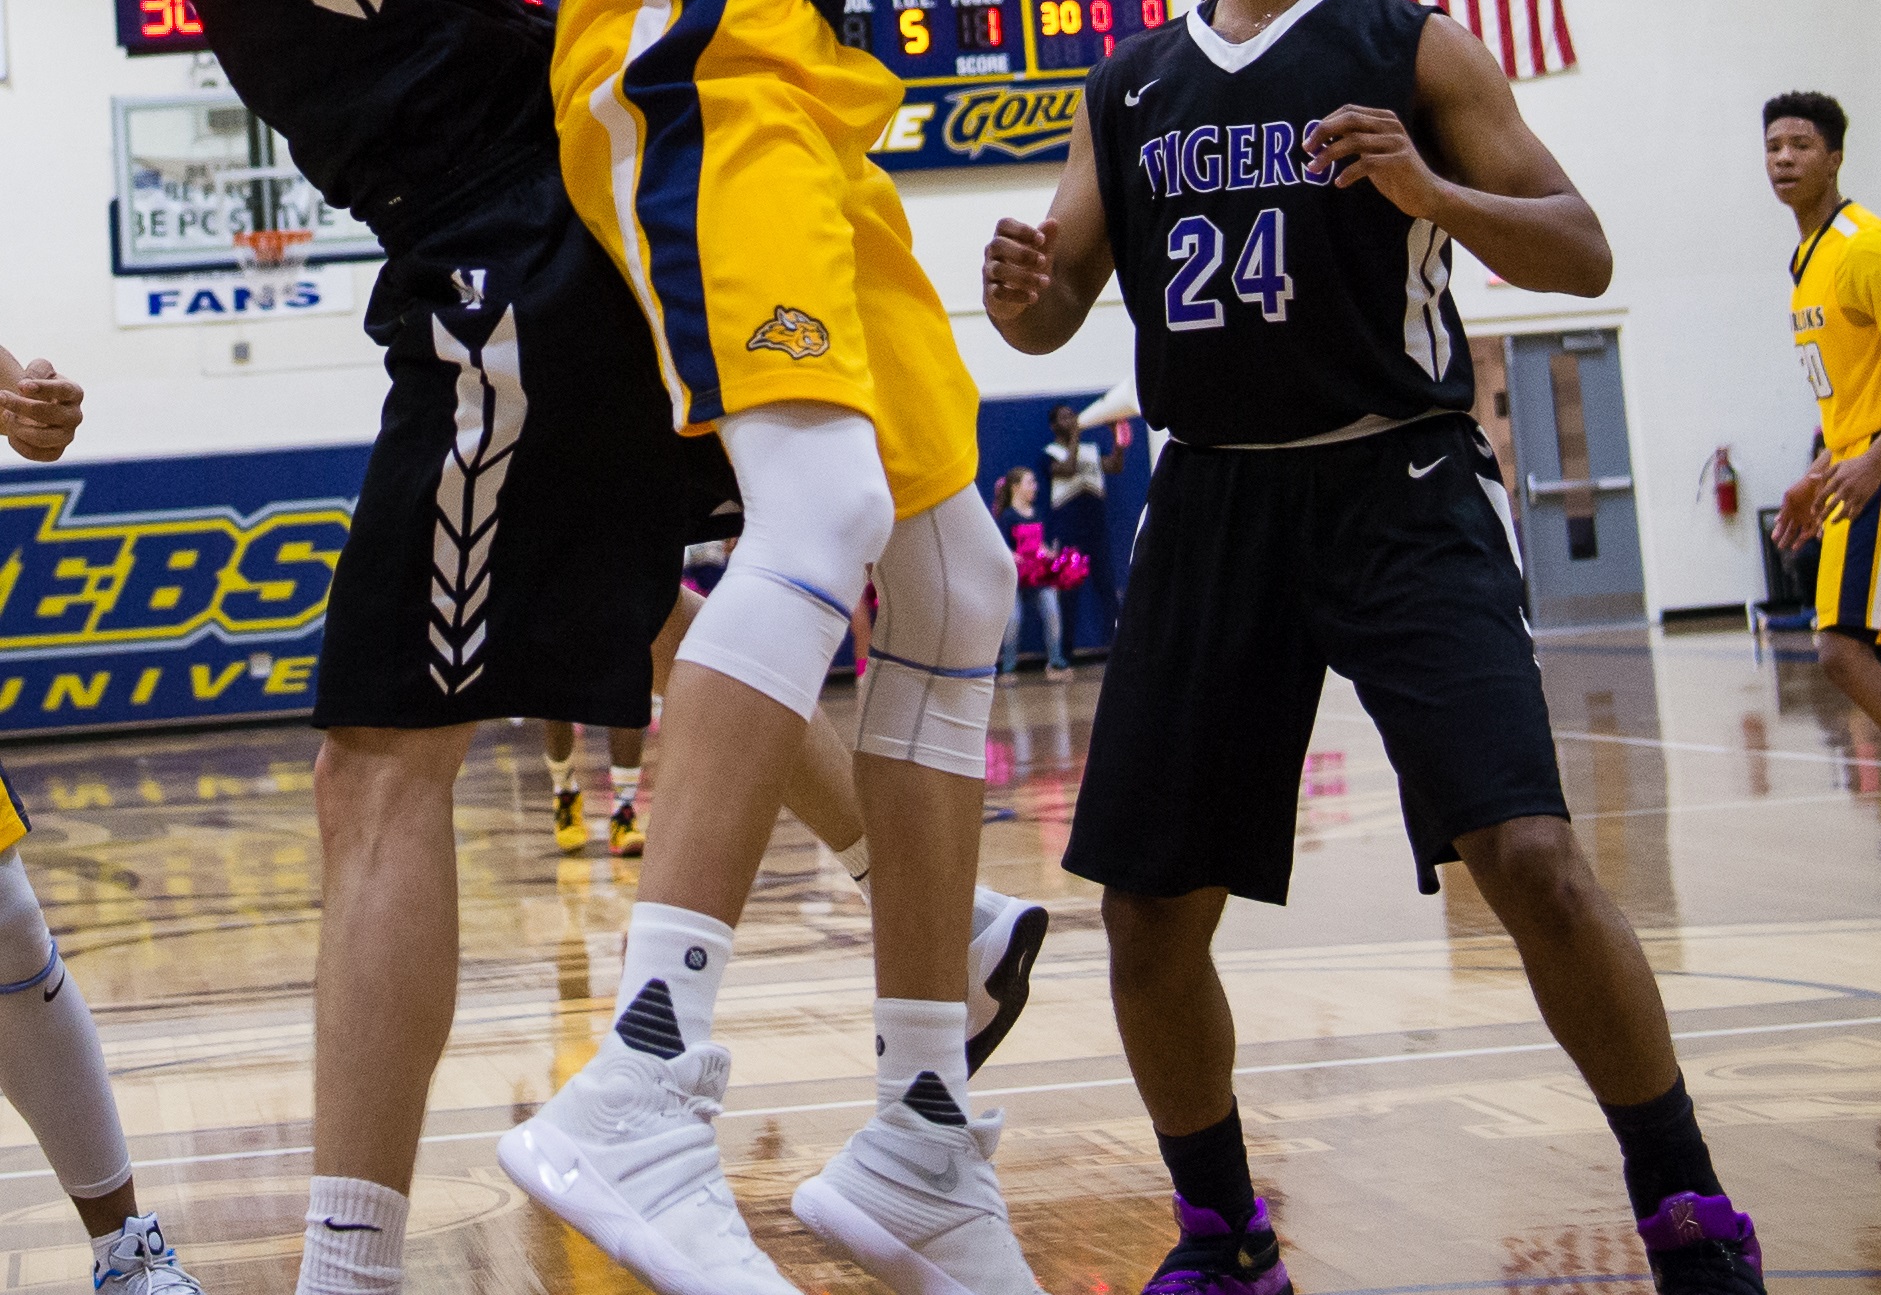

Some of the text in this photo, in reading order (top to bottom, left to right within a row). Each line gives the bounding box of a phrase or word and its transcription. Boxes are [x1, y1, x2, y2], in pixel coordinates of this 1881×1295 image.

[899, 7, 1002, 55] 5 1
[1040, 0, 1082, 36] 30
[1139, 120, 1336, 200] TIGERS
[1165, 207, 1295, 332] 24
[147, 280, 321, 317] FANS
